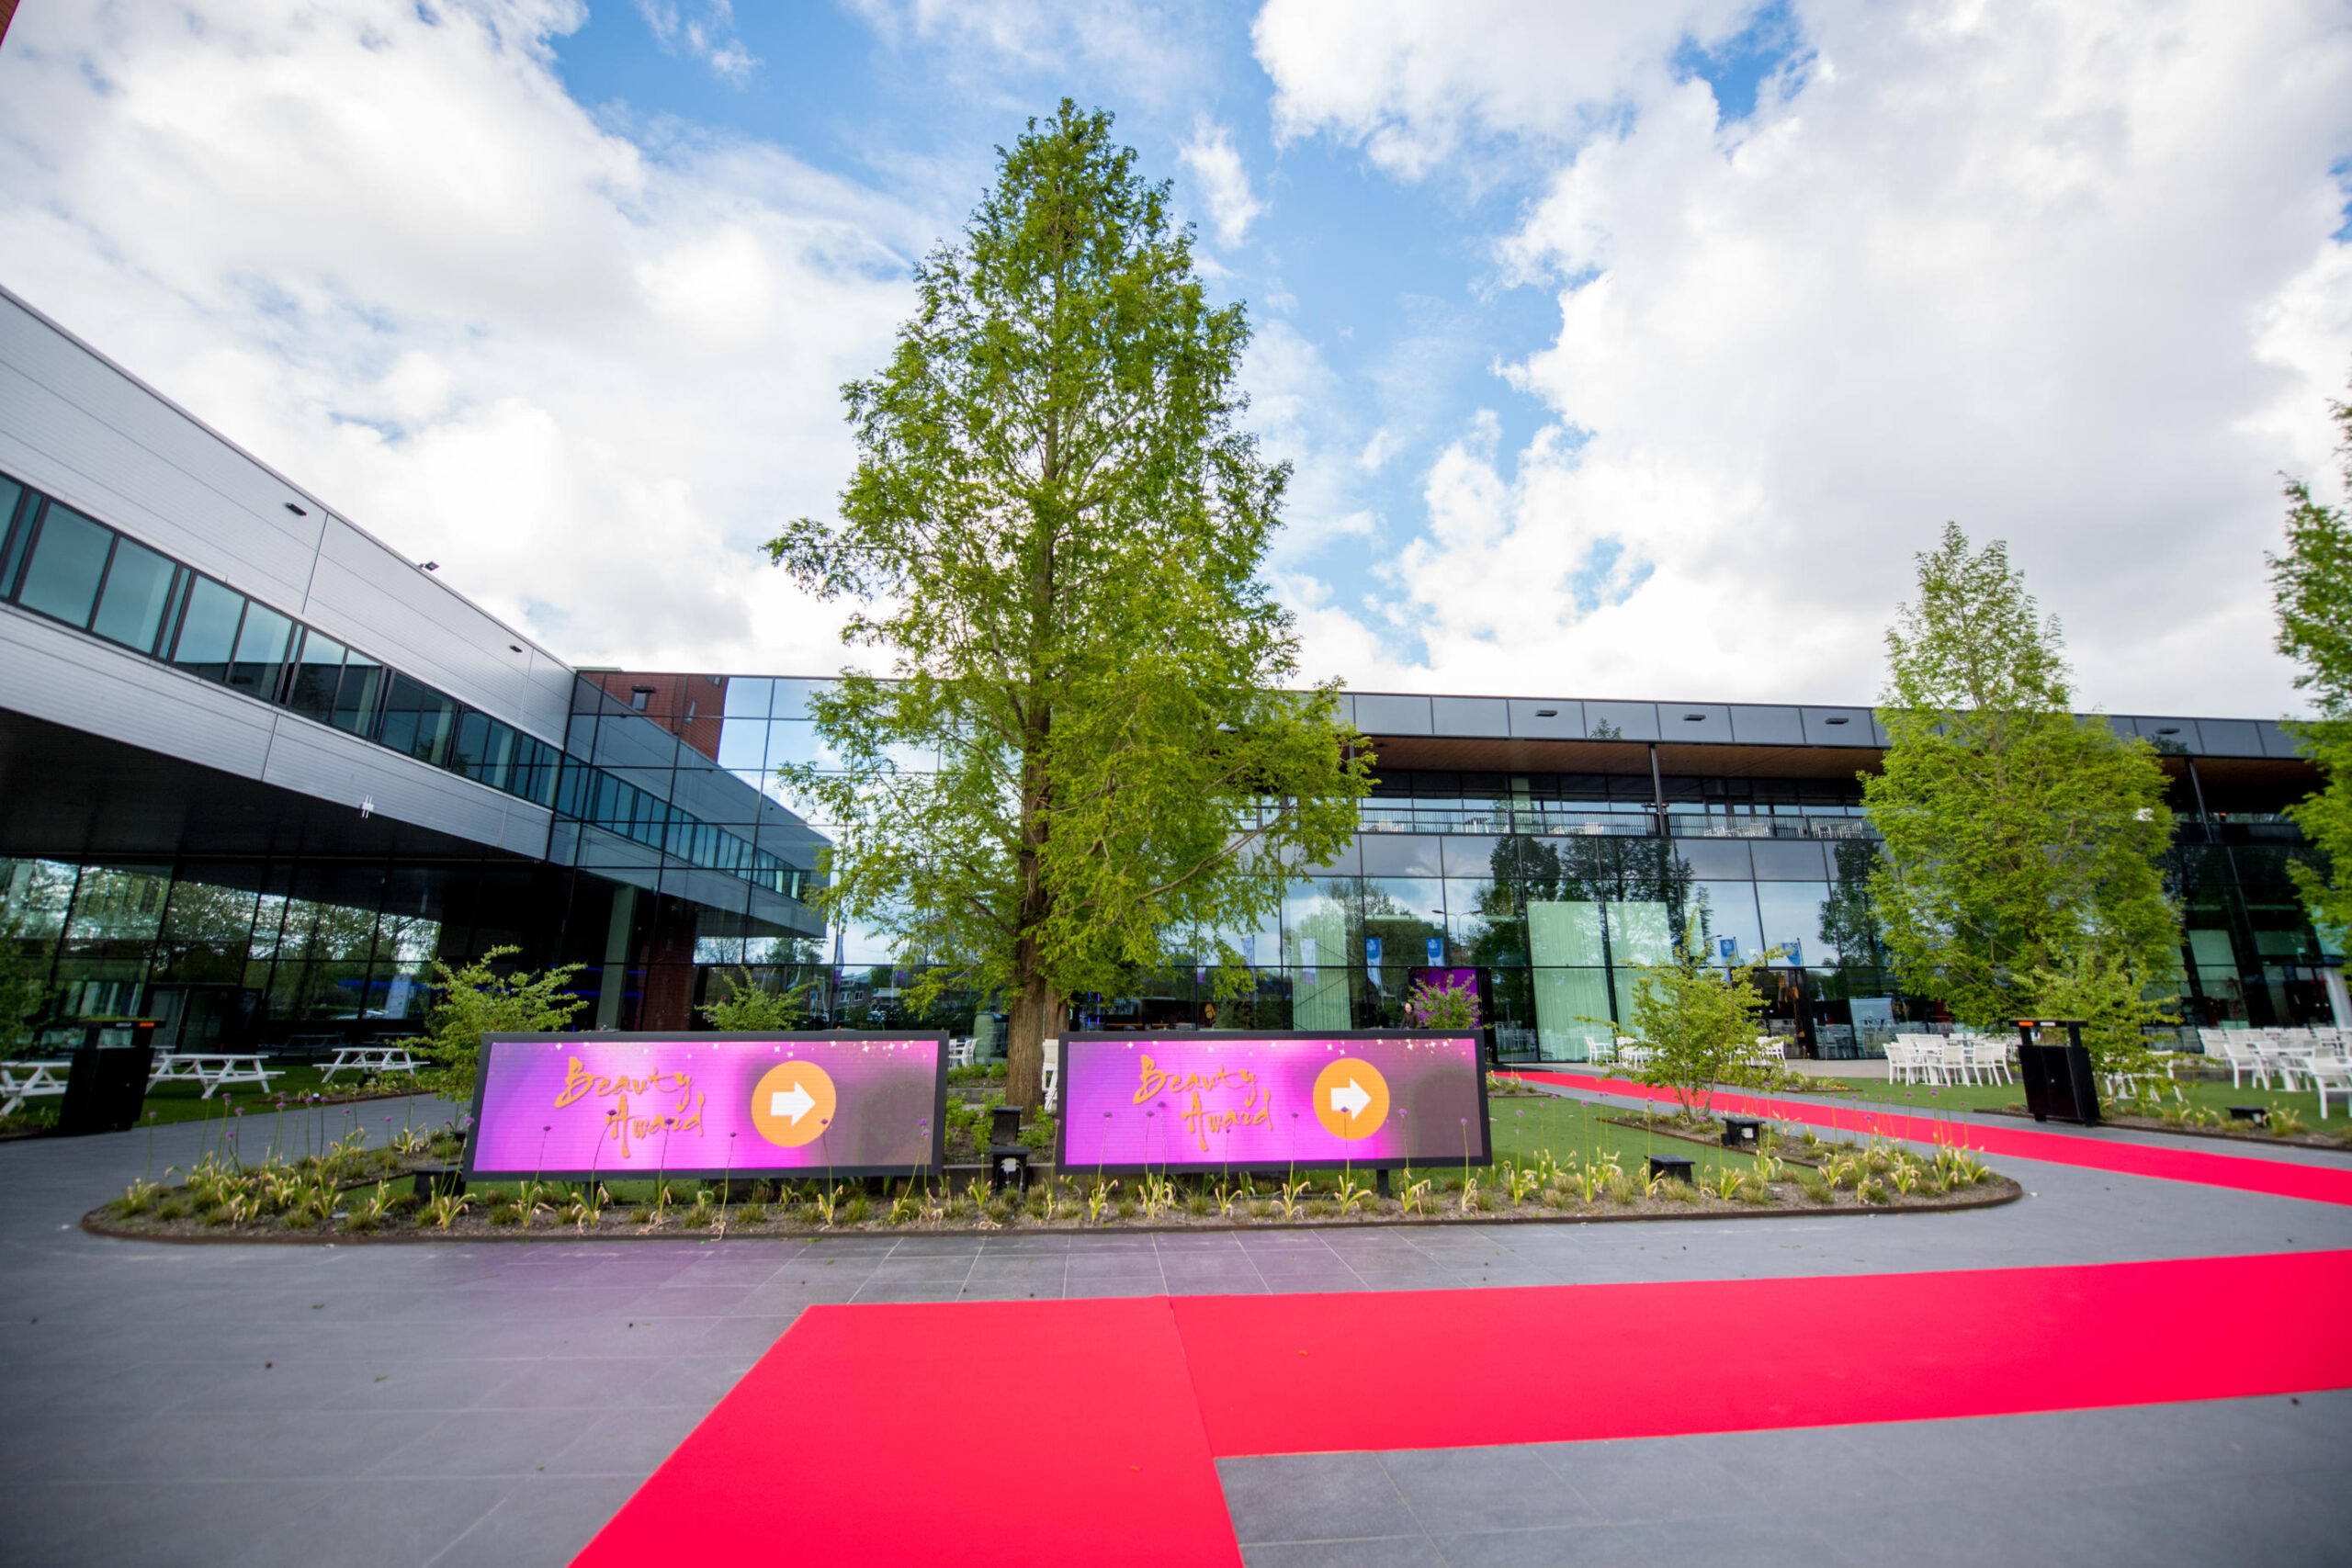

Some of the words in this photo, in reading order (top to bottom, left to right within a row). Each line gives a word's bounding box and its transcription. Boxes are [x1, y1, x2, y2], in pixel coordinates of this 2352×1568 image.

[554, 1056, 693, 1112] Beauty
[1133, 1055, 1256, 1108] Beauty
[605, 1091, 705, 1157] Award
[1182, 1088, 1272, 1152] Award
